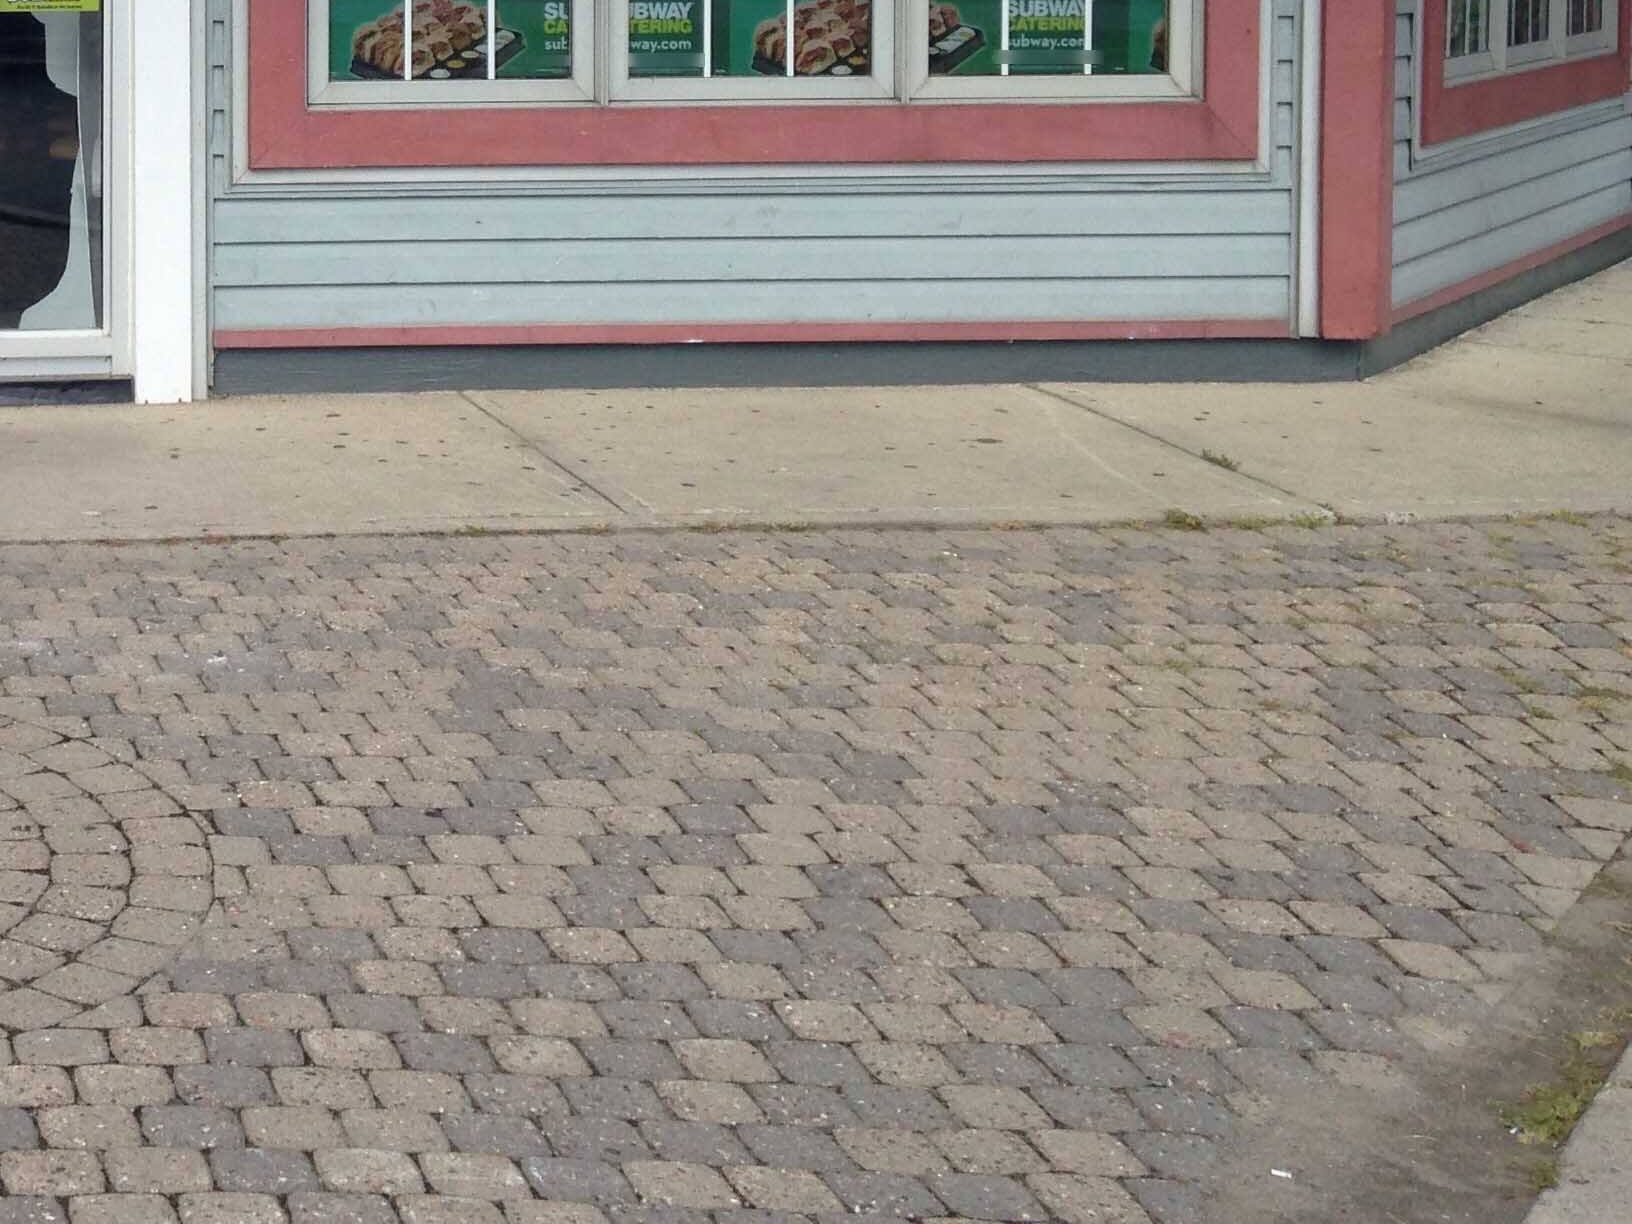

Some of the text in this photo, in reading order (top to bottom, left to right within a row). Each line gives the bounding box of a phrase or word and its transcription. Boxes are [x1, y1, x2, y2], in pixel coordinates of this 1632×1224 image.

[629, 2, 694, 19] BWAY
[629, 19, 693, 34] TERING
[1008, 17, 1086, 32] CATERIN
[630, 38, 692, 53] way.com
